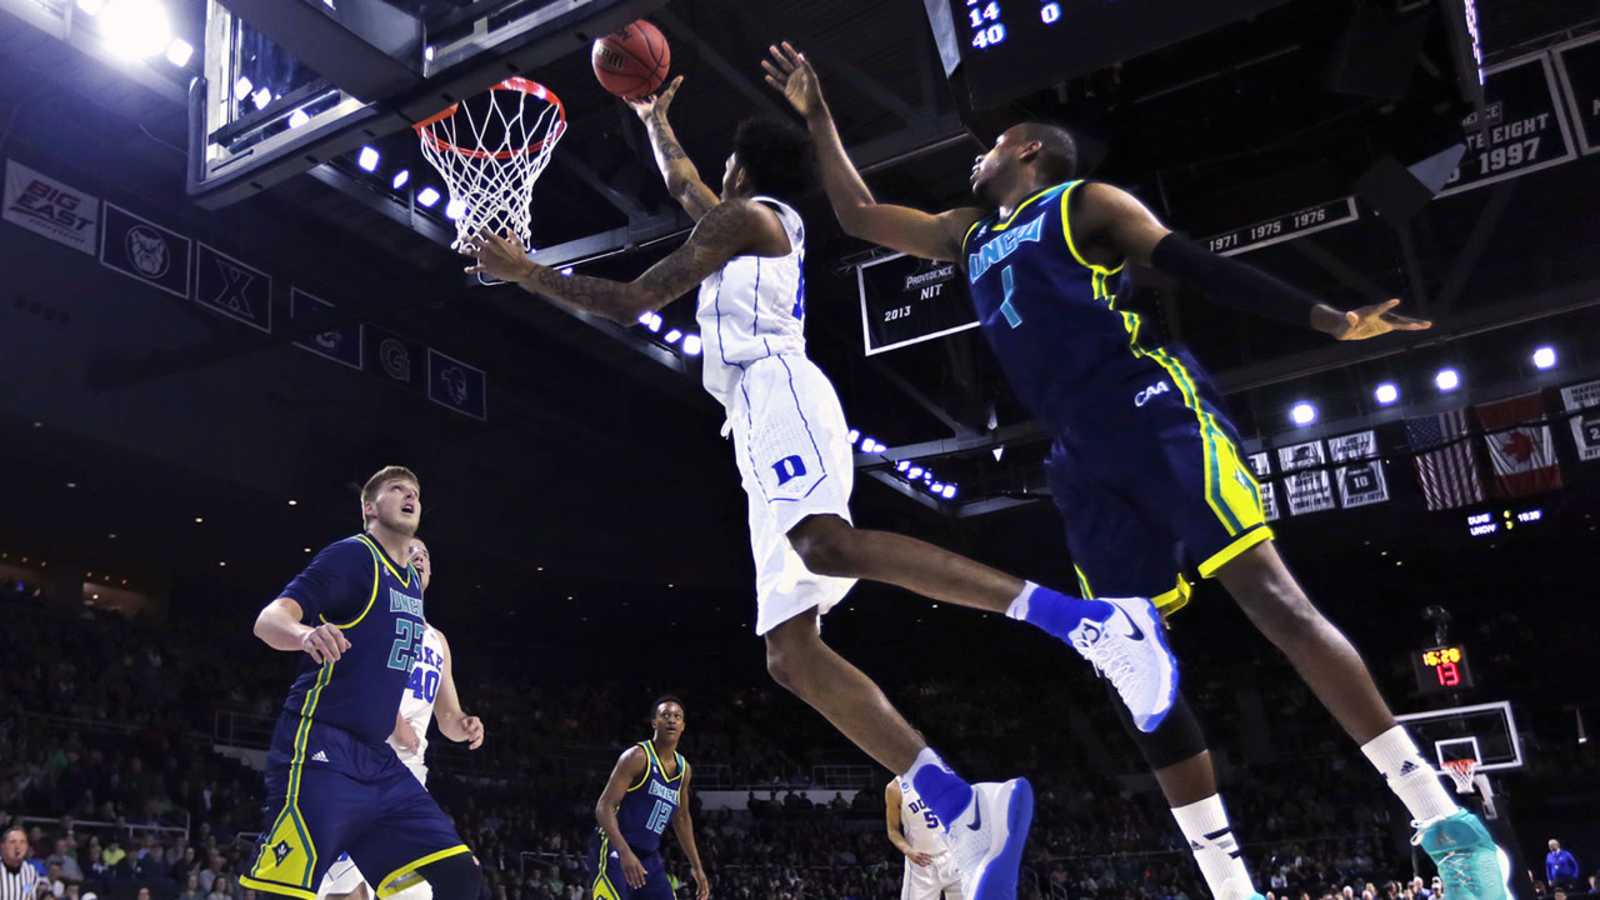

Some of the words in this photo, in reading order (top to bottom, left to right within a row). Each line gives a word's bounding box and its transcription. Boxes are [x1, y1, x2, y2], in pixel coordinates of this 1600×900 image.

[969, 1, 1000, 28] 14
[972, 23, 1006, 48] 40
[1041, 2, 1061, 25] 0
[1492, 113, 1549, 144] EIGHT
[1479, 137, 1540, 175] 1997
[27, 179, 80, 211] BIG
[16, 193, 94, 231] EAST
[1209, 233, 1239, 252] 1971
[1251, 220, 1281, 240] 1975
[1294, 208, 1326, 228] 1976
[969, 211, 1046, 284] UNCW
[920, 283, 943, 301] NIT
[1000, 264, 1022, 329] 1
[884, 305, 911, 322] 2013
[1134, 381, 1169, 407] CAA
[771, 454, 807, 487] D
[1354, 476, 1369, 489] 10
[406, 666, 440, 705] 40
[1436, 662, 1460, 686] 13
[645, 799, 673, 835] 12
[908, 799, 927, 814] DU
[923, 811, 939, 829] 5
